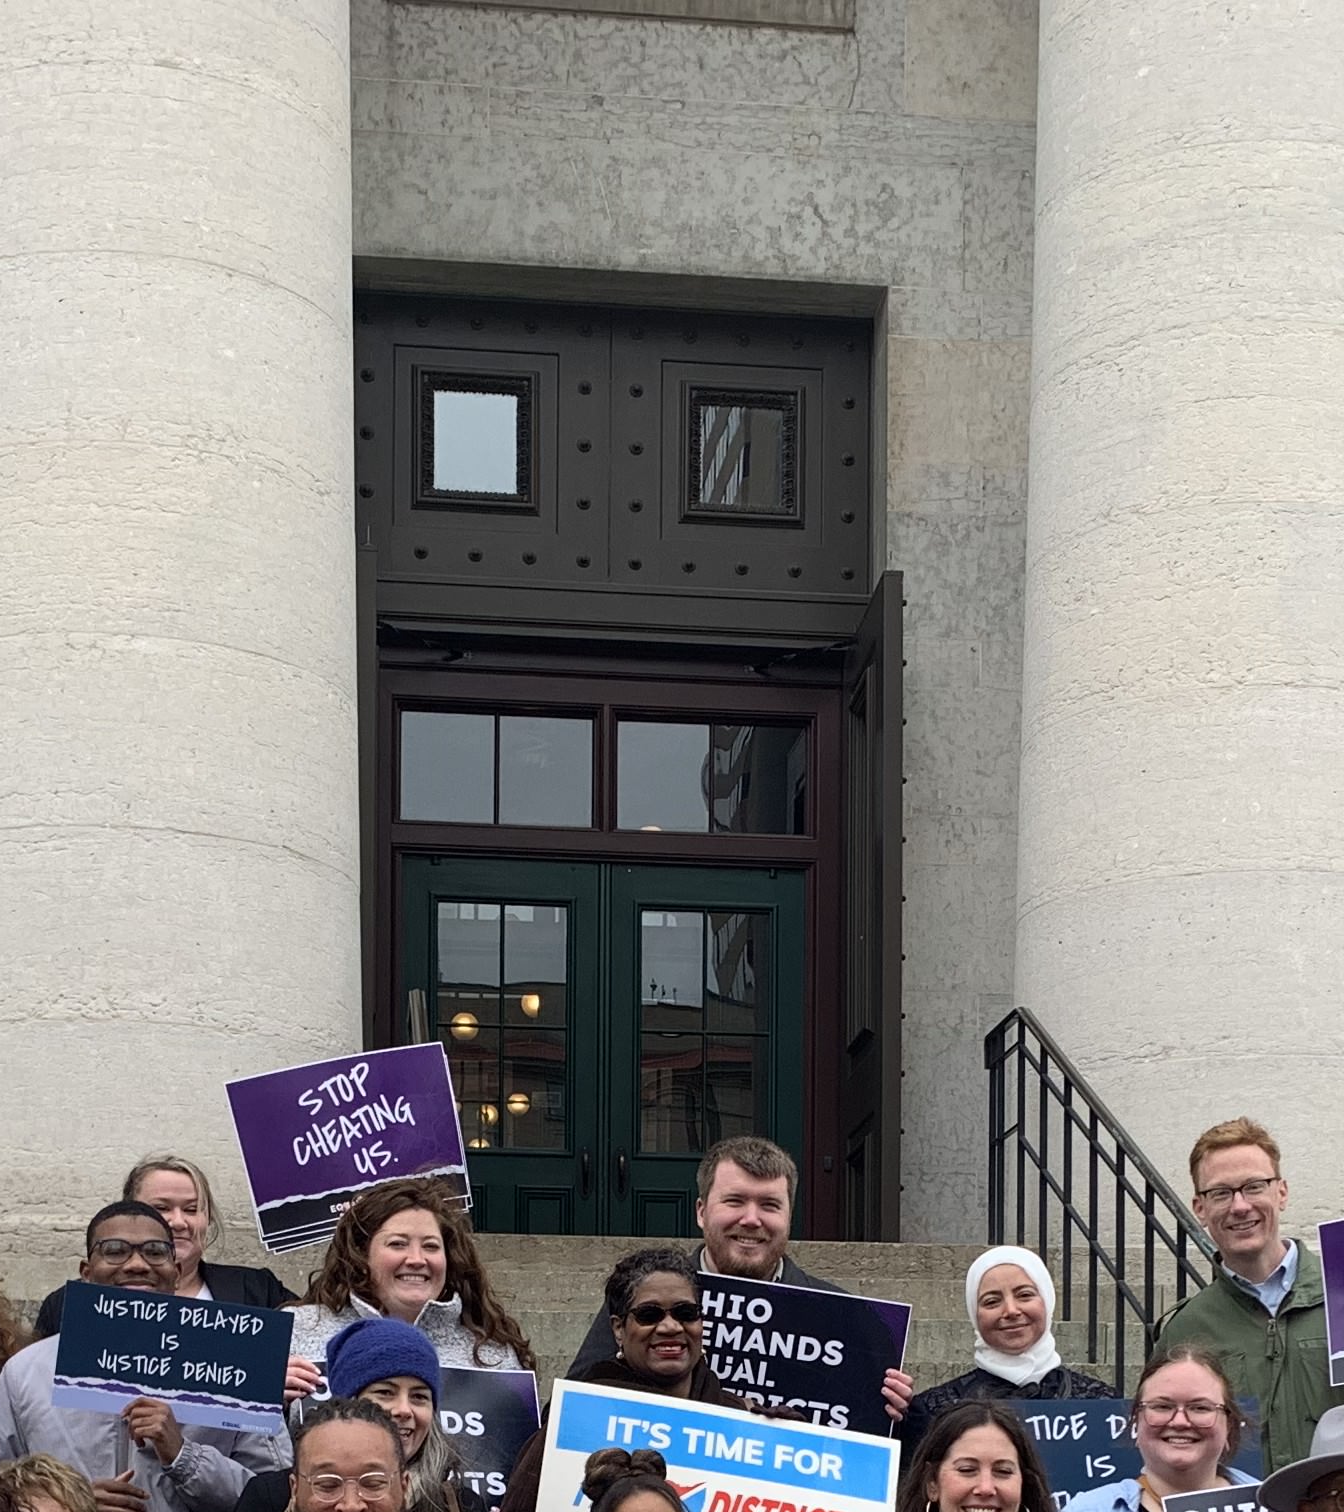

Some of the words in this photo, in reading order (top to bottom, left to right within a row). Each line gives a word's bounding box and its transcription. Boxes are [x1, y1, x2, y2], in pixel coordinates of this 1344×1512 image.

[298, 1062, 369, 1115] STOP
[293, 1094, 415, 1165] CHEATING
[354, 1140, 398, 1175] US.
[94, 1294, 168, 1321] JUSTICE
[179, 1307, 264, 1335] DELAYED
[701, 1290, 773, 1323] HIO
[161, 1333, 179, 1350] IS
[701, 1321, 844, 1366] EMANDS
[97, 1349, 171, 1376] JUSTICE
[182, 1361, 247, 1387] DENIED
[704, 1352, 775, 1387] UAL
[1025, 1412, 1087, 1440] TICE
[607, 1415, 671, 1449] IT'S
[682, 1426, 765, 1466] TIME
[774, 1444, 843, 1481] FOR
[1086, 1455, 1116, 1477] IS
